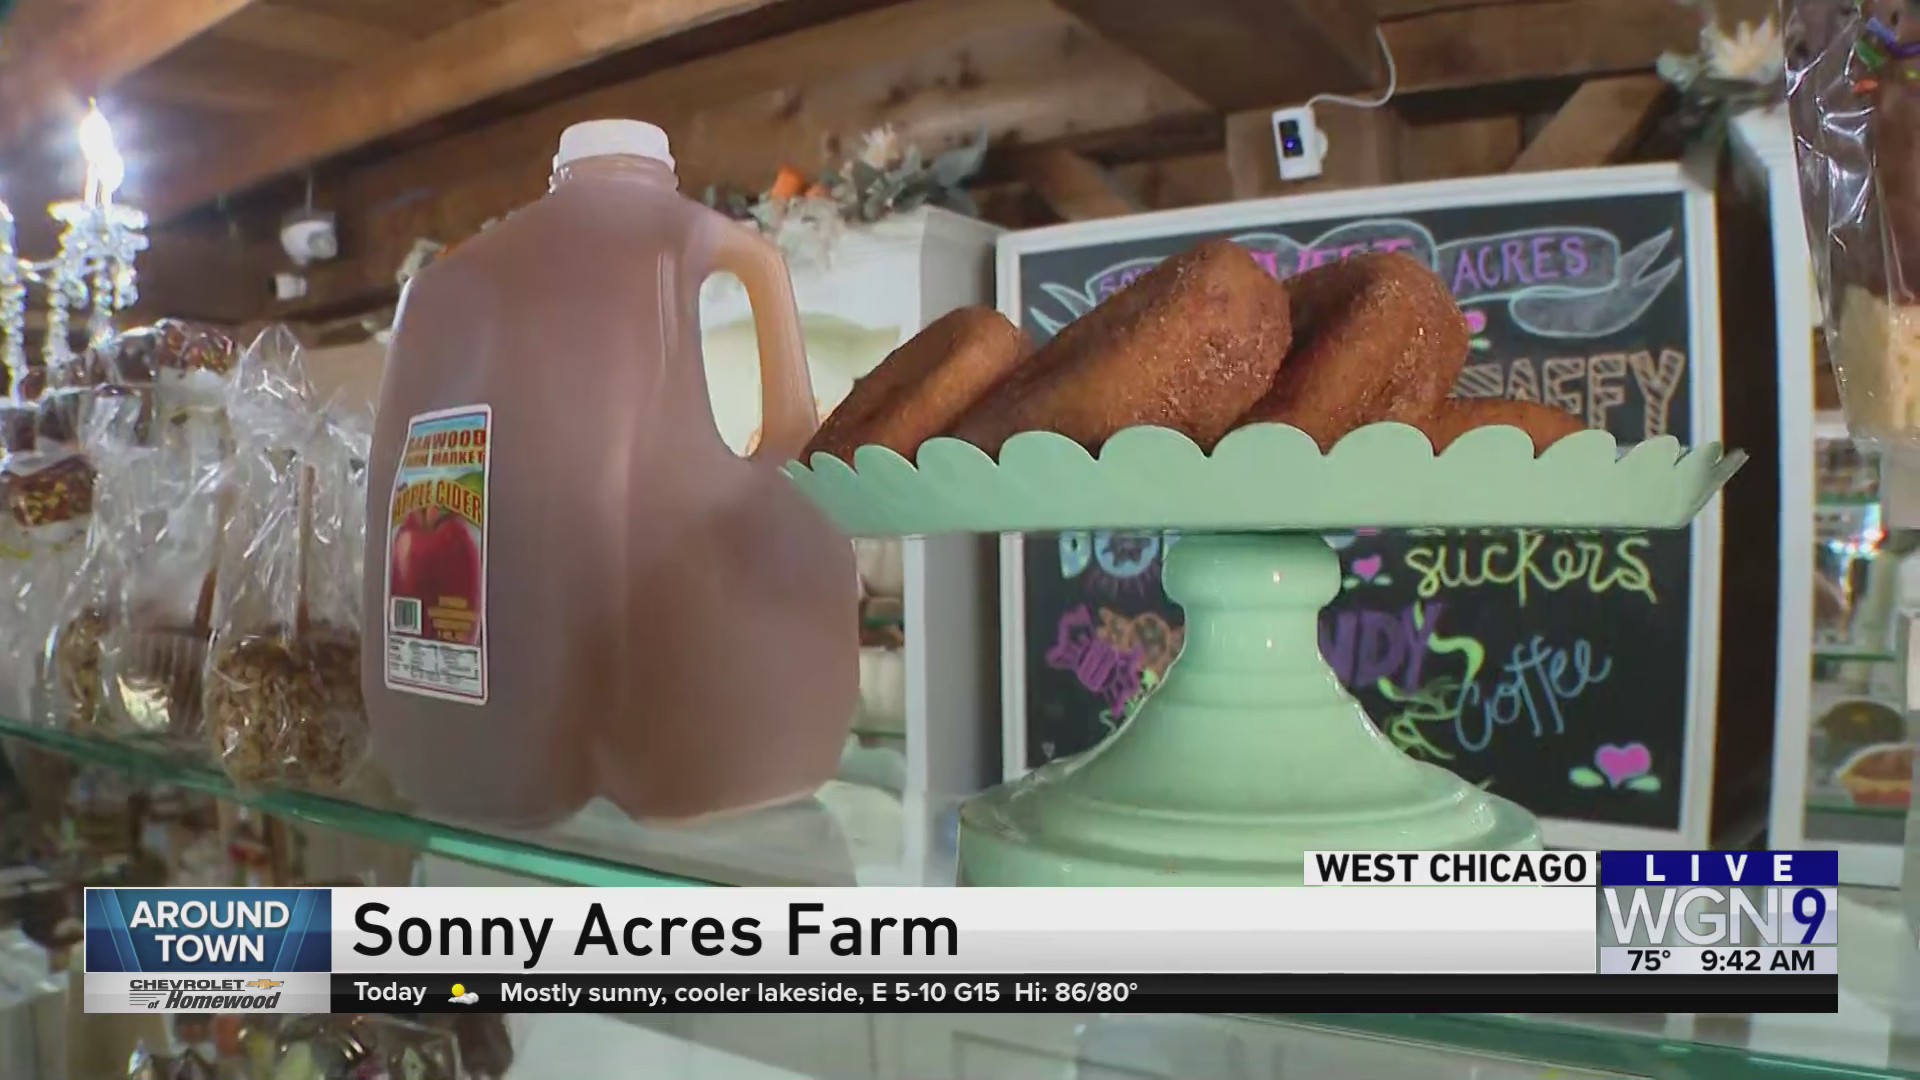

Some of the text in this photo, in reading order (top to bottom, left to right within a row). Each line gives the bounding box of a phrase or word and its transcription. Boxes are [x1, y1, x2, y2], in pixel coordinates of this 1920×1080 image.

[1453, 236, 1588, 293] ACRES
[393, 479, 481, 523] APPLE CIDER
[1455, 635, 1612, 751] Coffee
